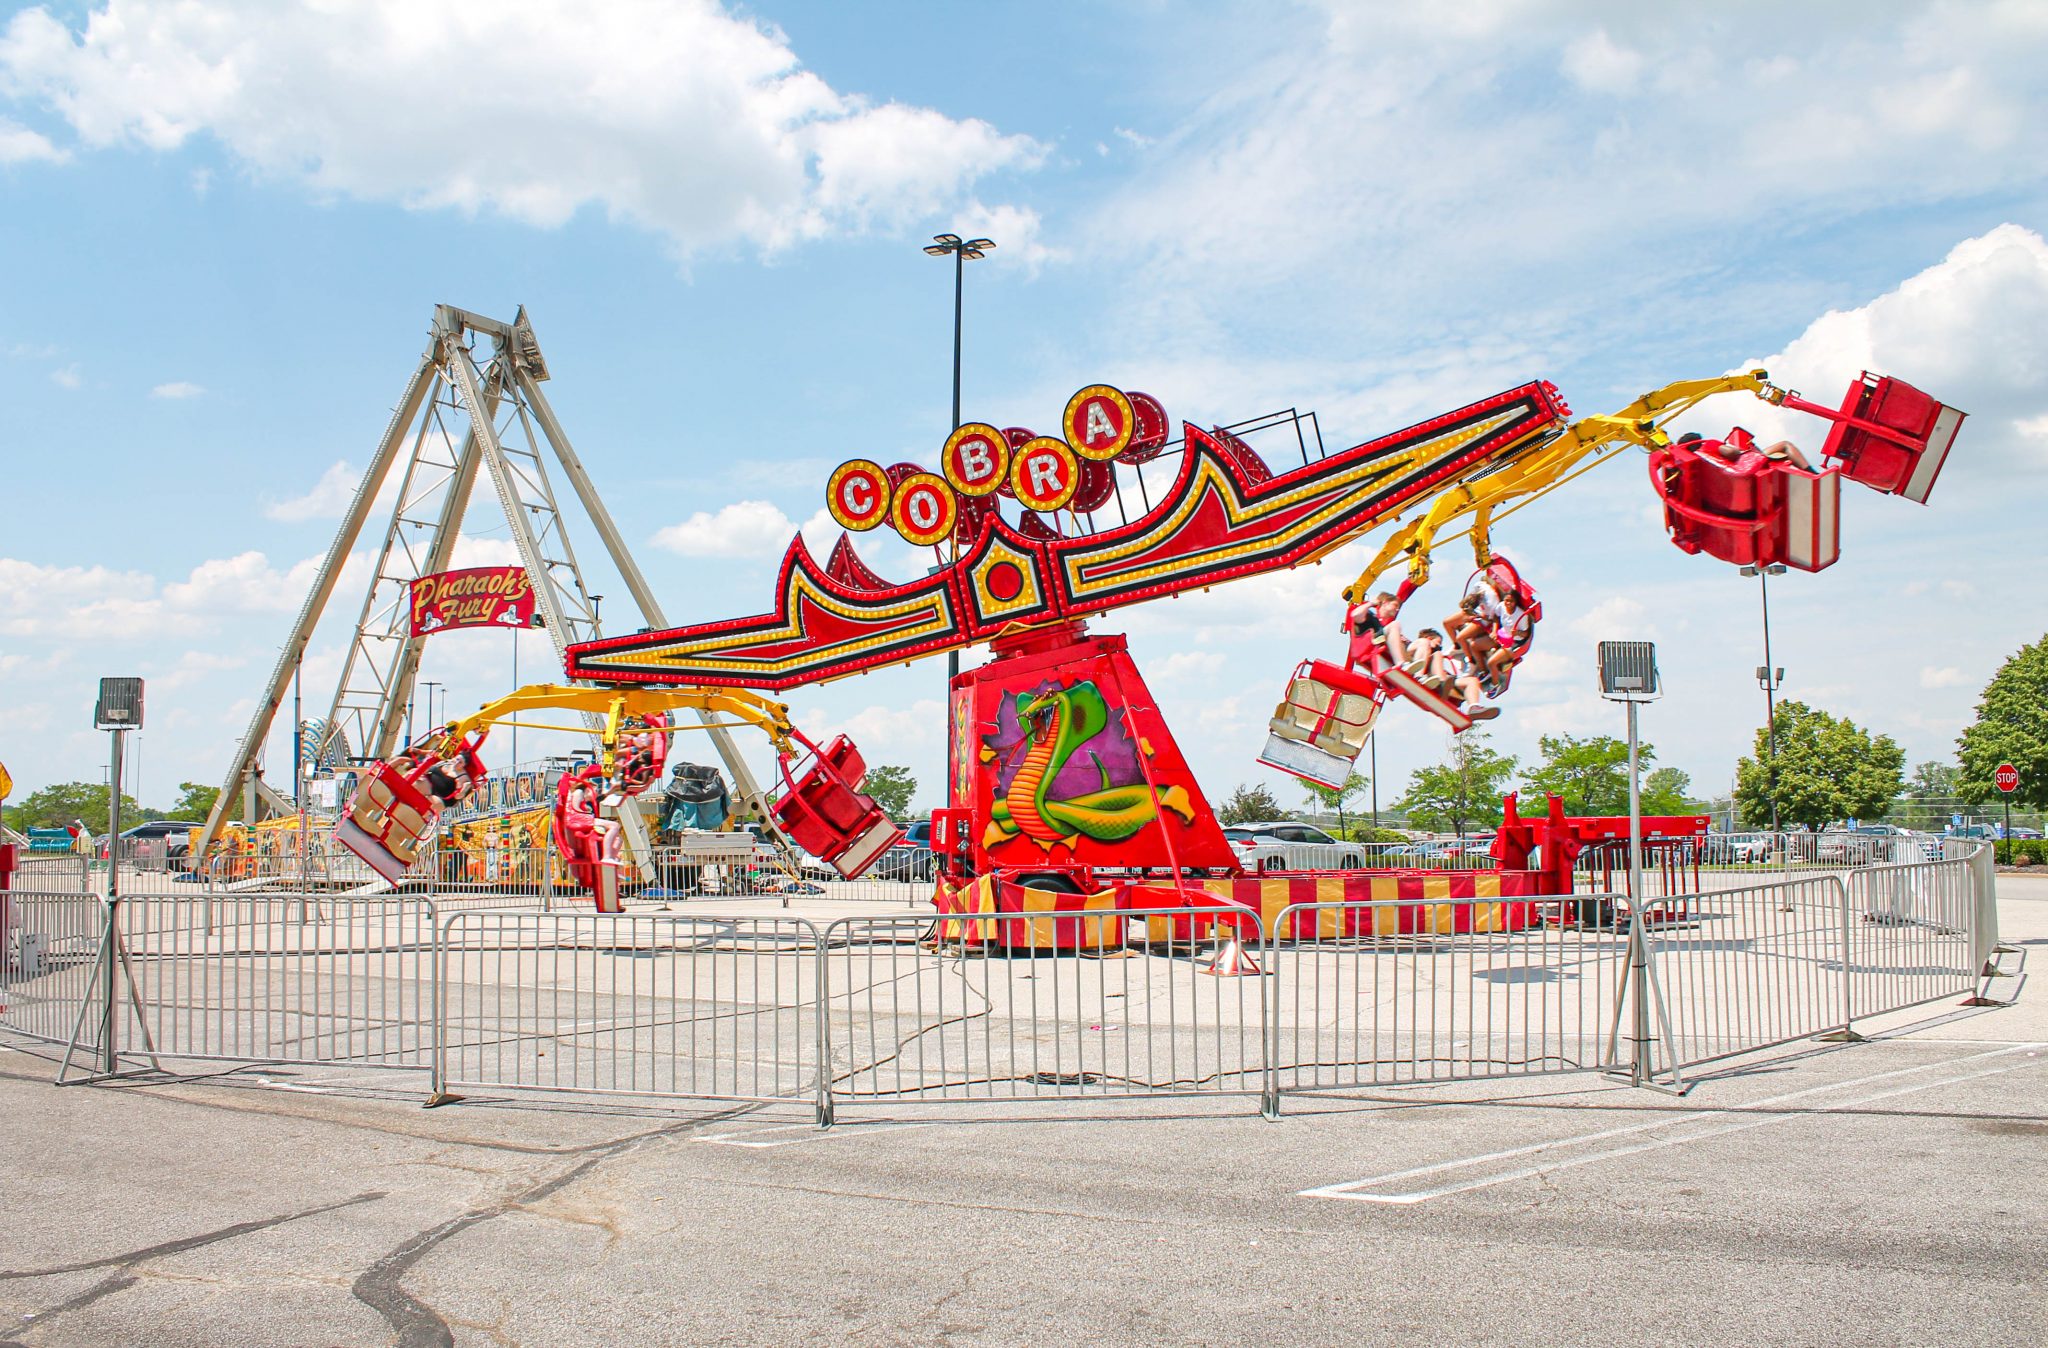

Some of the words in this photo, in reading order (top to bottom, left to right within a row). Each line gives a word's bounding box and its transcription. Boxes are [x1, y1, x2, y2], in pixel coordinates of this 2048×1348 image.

[843, 401, 1117, 528] COBRA
[413, 569, 531, 623] Pharaoh's
[439, 598, 499, 626] Fury
[1996, 773, 2017, 784] STOP
